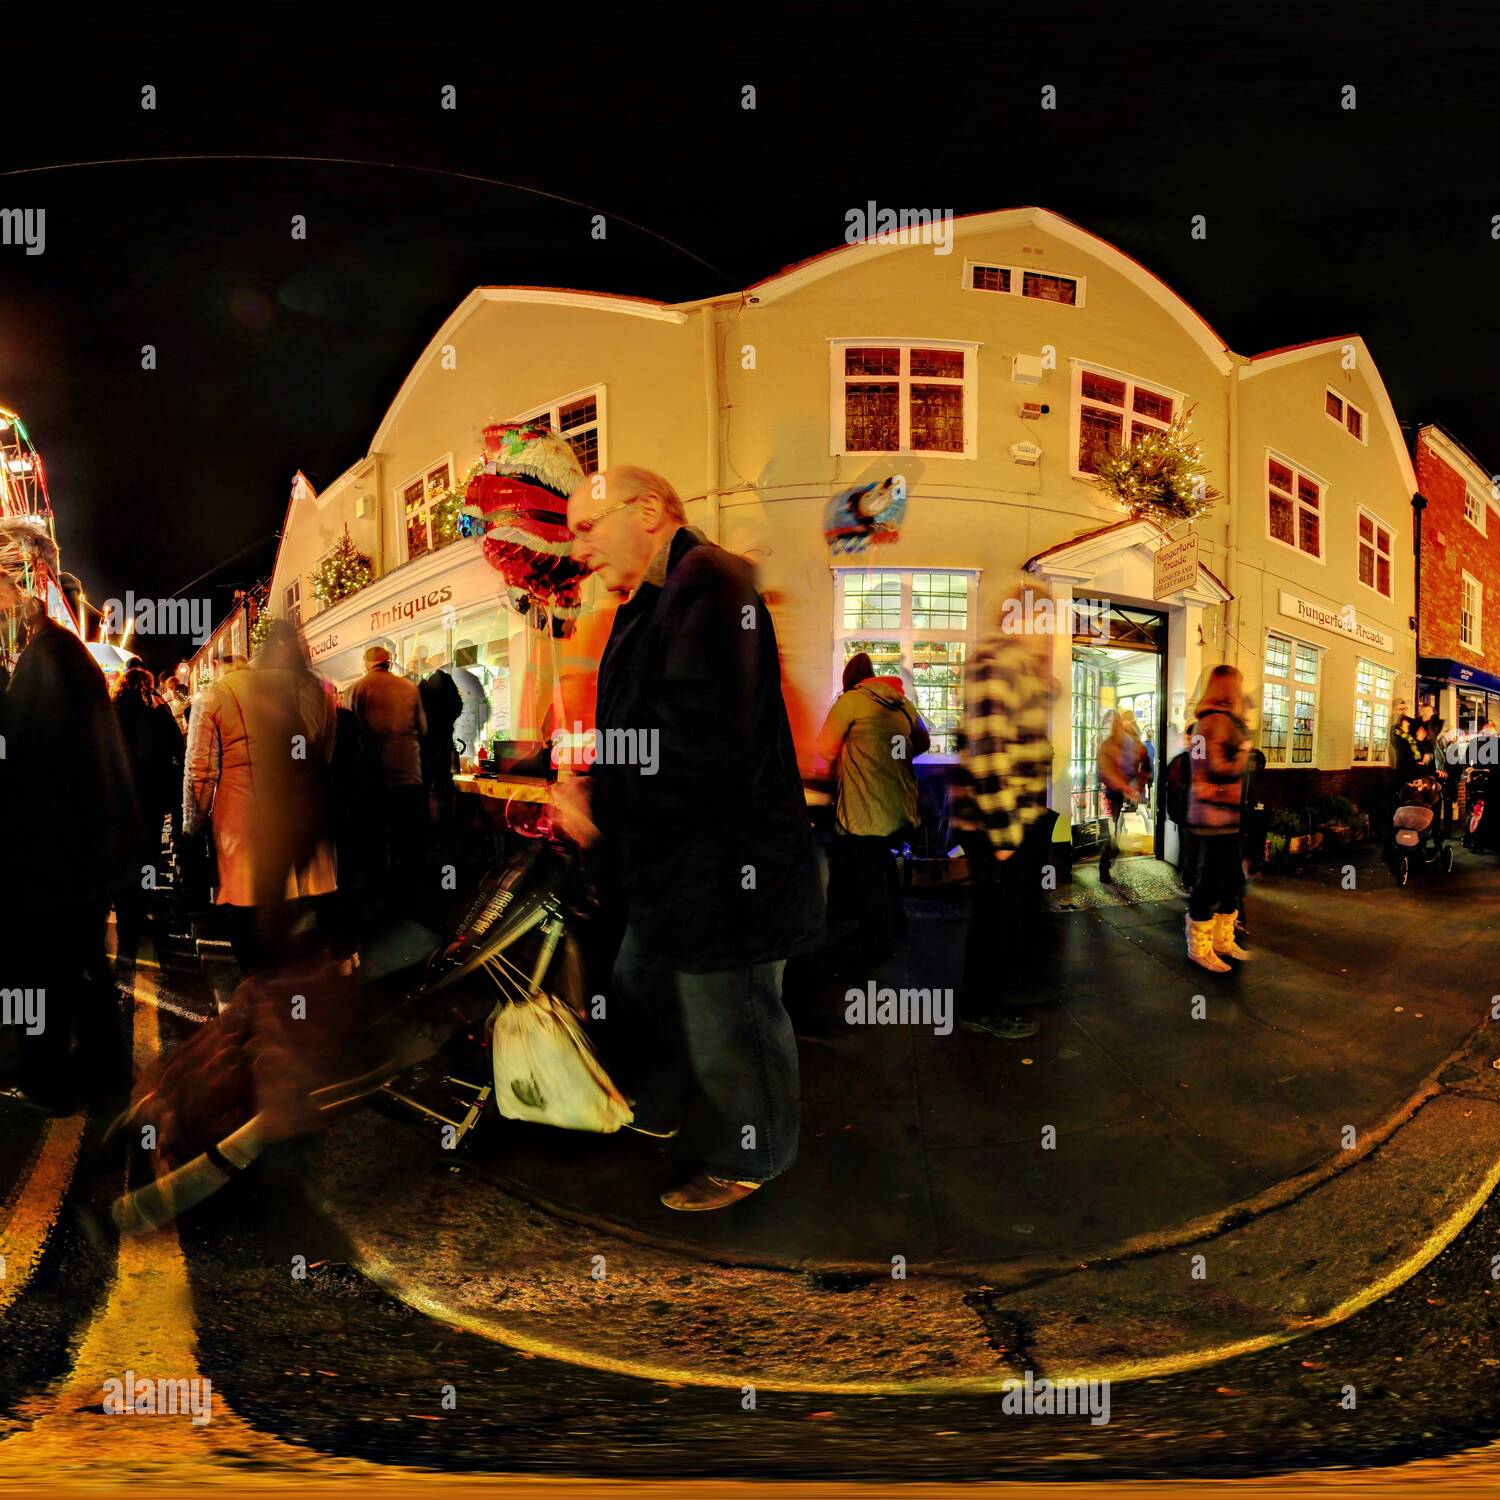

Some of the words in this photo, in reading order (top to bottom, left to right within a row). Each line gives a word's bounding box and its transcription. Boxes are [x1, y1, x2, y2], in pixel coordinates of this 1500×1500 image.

[1157, 538, 1196, 565] Hungerford
[370, 585, 453, 631] Antiques
[1297, 599, 1353, 633] Hungerford
[1356, 623, 1385, 646] Arcade
